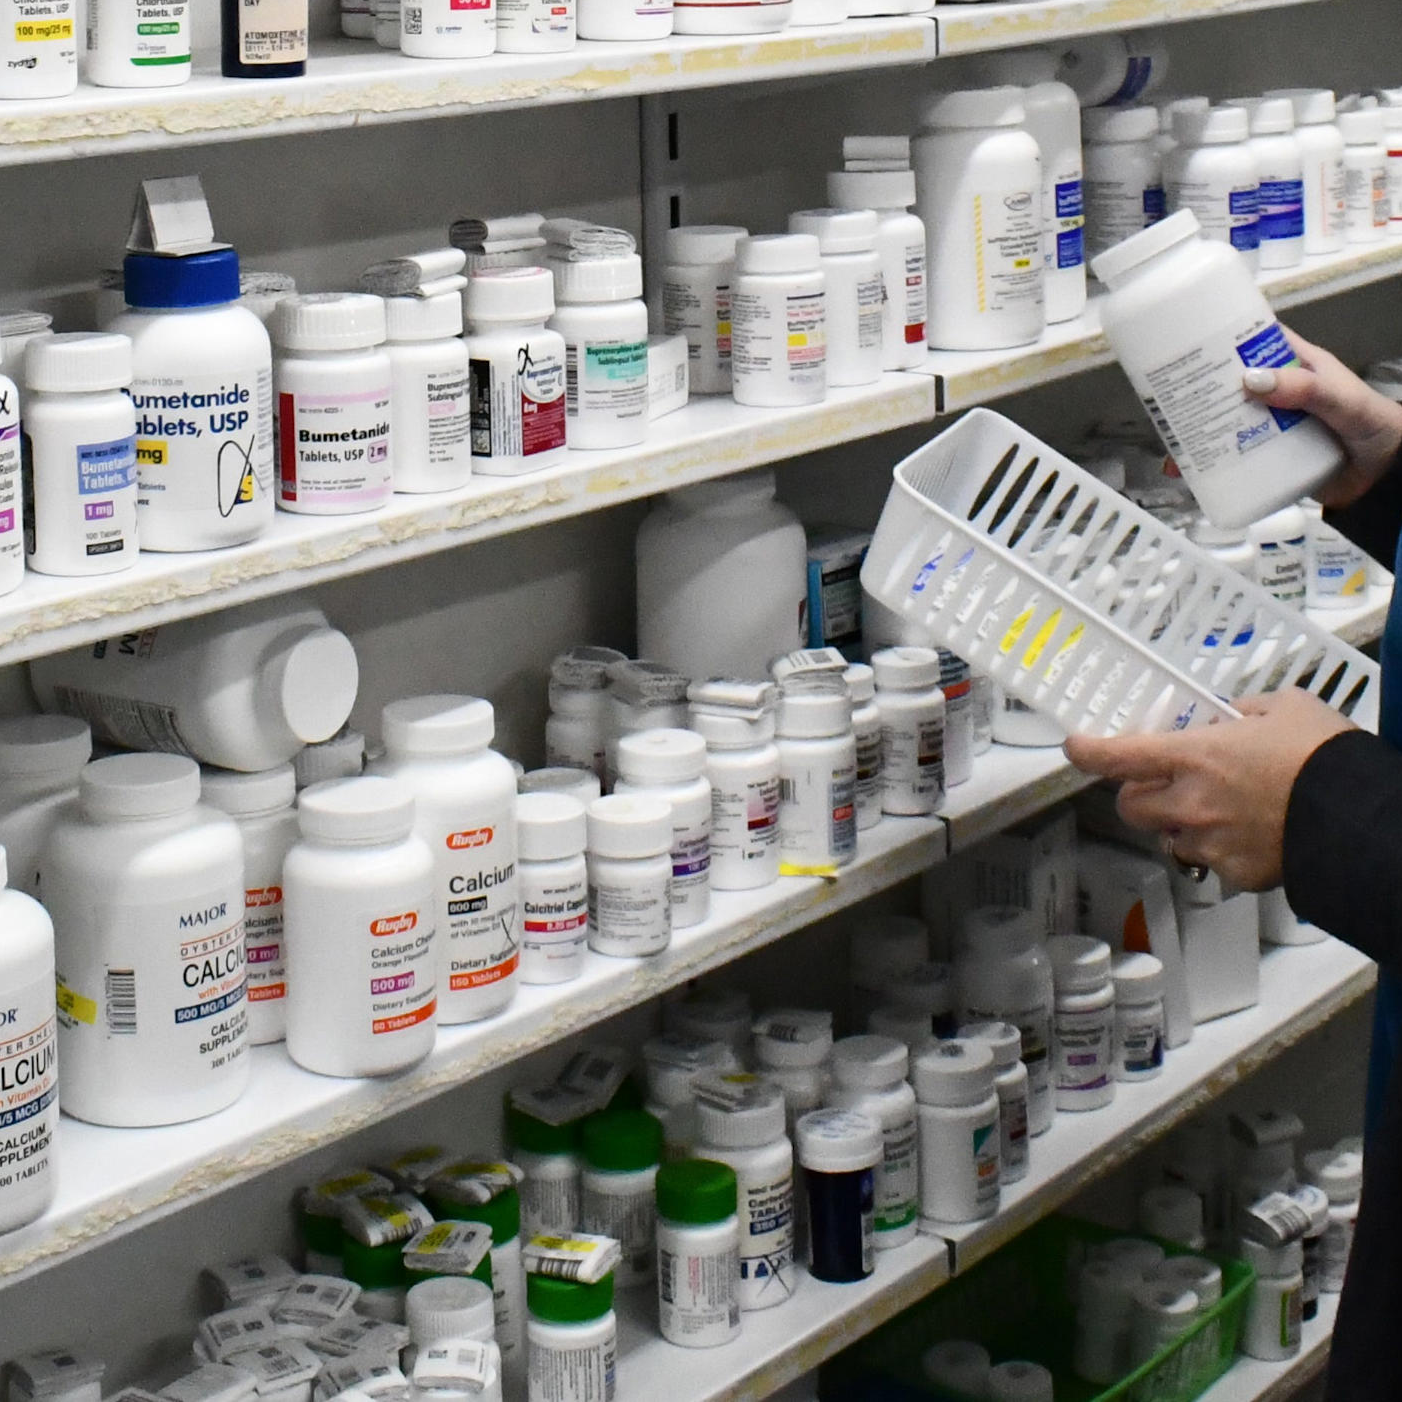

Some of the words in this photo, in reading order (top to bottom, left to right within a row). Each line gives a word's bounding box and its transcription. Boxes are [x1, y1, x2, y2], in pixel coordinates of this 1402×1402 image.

[19, 7, 53, 15] Tablets,
[136, 9, 170, 17] Tablets,
[18, 26, 33, 35] 100
[36, 24, 61, 36] mg/25
[136, 411, 202, 438] ablets,
[210, 411, 248, 433] USP
[137, 449, 163, 464] mg
[300, 450, 341, 462] Tablets,
[344, 449, 364, 461] USP
[370, 447, 375, 457] 2
[87, 507, 92, 516] 1
[96, 504, 112, 515] mg
[452, 831, 489, 847] Rugby
[449, 863, 515, 894] Calcium
[472, 899, 487, 910] mg
[525, 902, 564, 914] Calcitriol
[180, 902, 227, 929] MAJOR
[376, 917, 413, 933] Rugby
[181, 933, 231, 957] OYSTER
[371, 939, 413, 959] Calcium
[260, 949, 279, 960] mg
[372, 958, 401, 970] Orange
[451, 956, 487, 971] Dietary
[373, 979, 395, 992] 500
[398, 974, 414, 988] mg
[472, 970, 501, 984] Tablets
[199, 986, 218, 999] with
[249, 987, 281, 998] Tablets
[177, 1010, 198, 1021] 500
[200, 1000, 224, 1016] MG/5
[373, 999, 403, 1012] Dietary
[388, 1015, 416, 1029] Tablets
[7, 1083, 42, 1105] Vitamin
[15, 1101, 39, 1119] MCG
